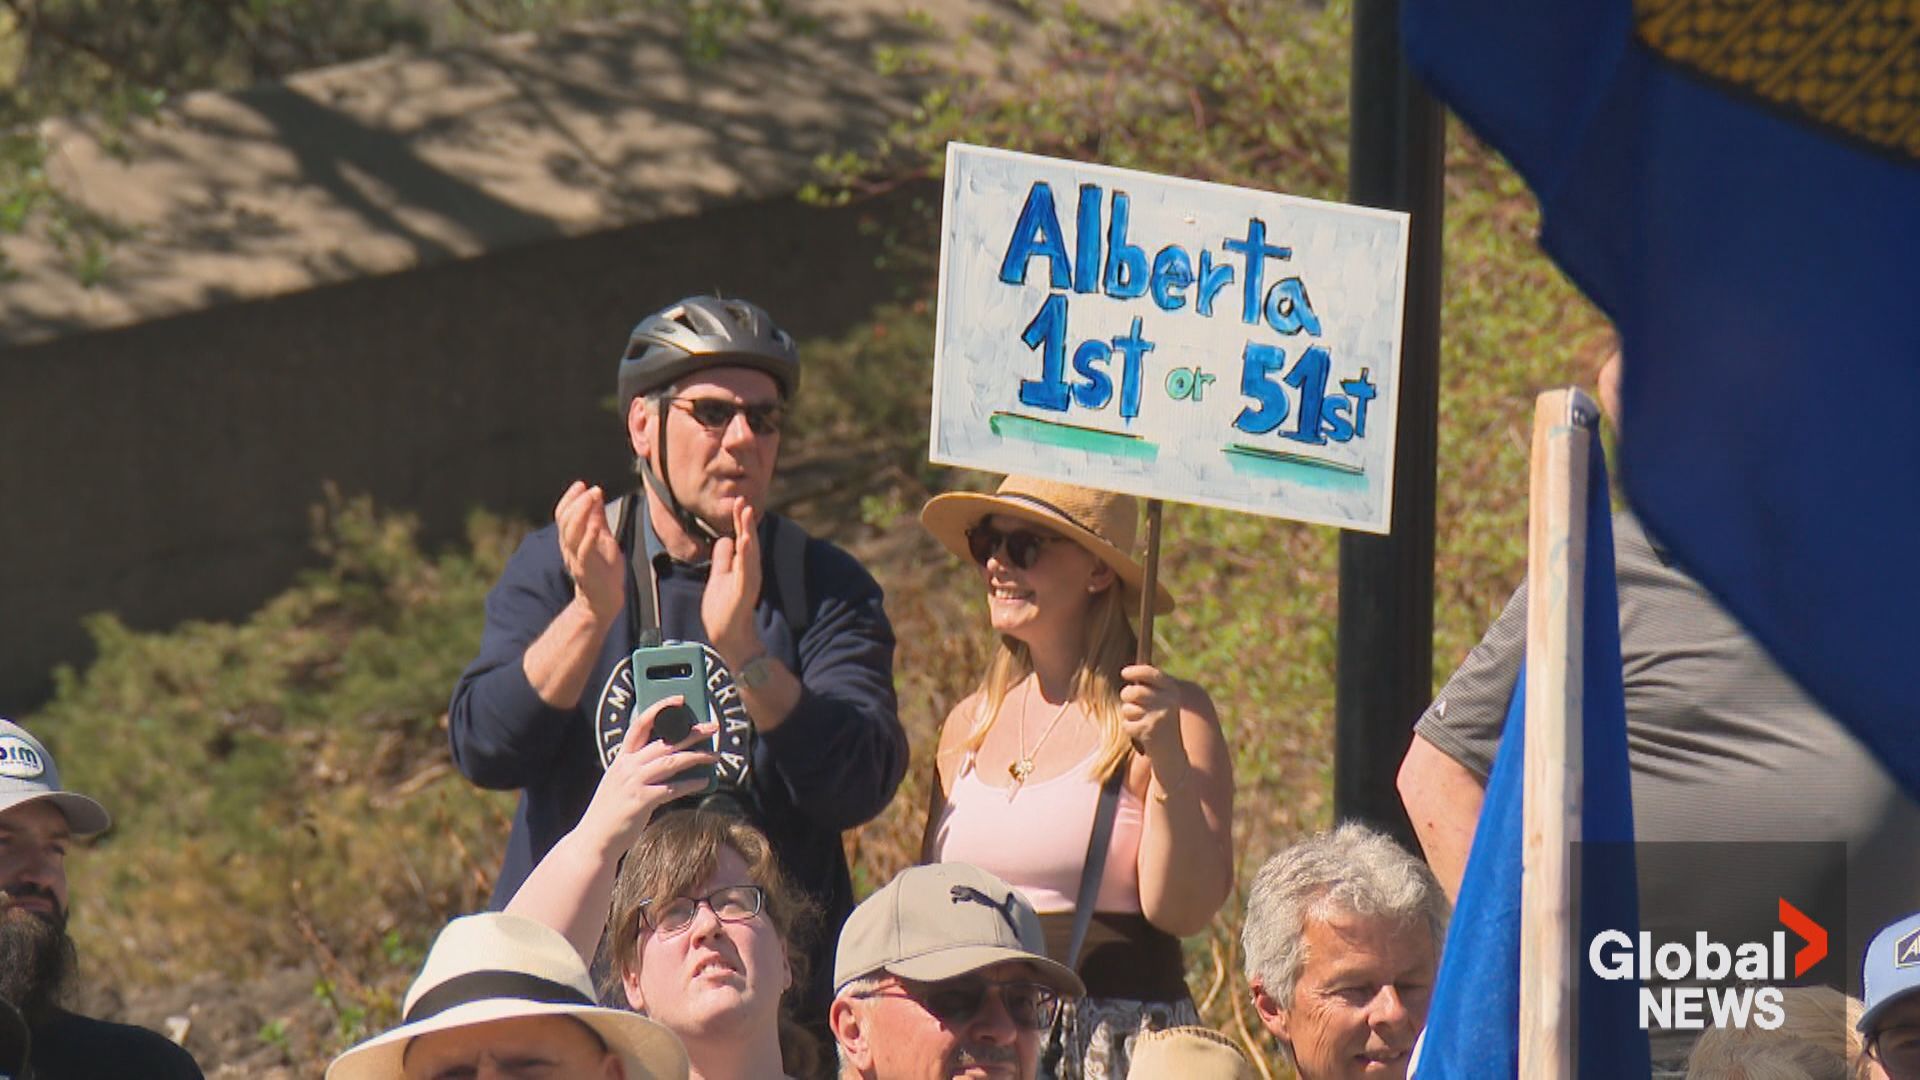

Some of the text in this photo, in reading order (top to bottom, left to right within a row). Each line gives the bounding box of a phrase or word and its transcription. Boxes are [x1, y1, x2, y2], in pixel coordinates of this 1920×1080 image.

[999, 181, 1322, 336] Alberta
[1019, 294, 1377, 446] 1st or 51st
